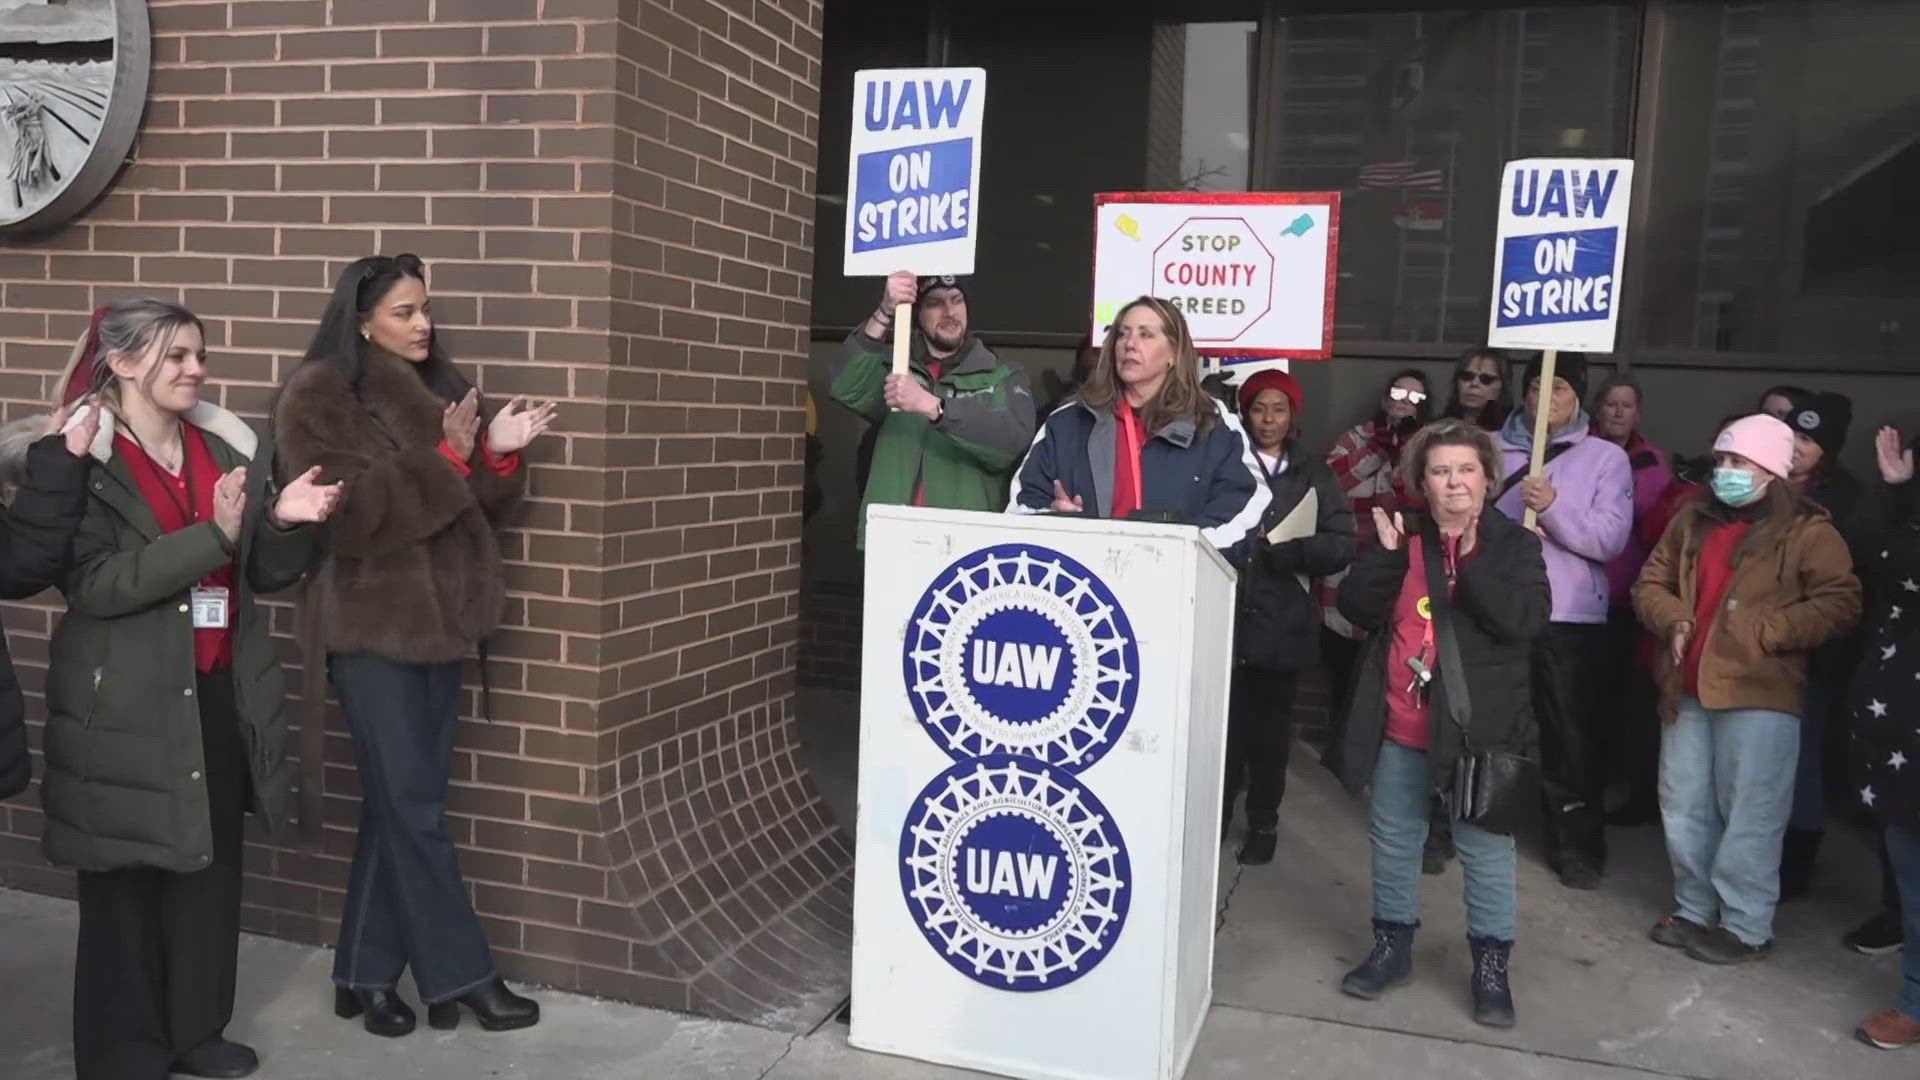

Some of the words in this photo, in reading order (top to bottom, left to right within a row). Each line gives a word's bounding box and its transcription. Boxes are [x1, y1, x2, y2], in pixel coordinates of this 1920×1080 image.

[865, 79, 971, 132] UAW
[888, 150, 931, 193] ON
[1511, 169, 1619, 219] UAW
[858, 189, 969, 243] STRIKE
[1182, 235, 1241, 252] STOP
[1534, 237, 1577, 275] ON
[1164, 262, 1256, 287] COUNTY
[1169, 296, 1245, 315] GREED
[1502, 275, 1612, 318] STRIKE
[973, 639, 1063, 691] UAW
[966, 848, 1059, 900] UAW
